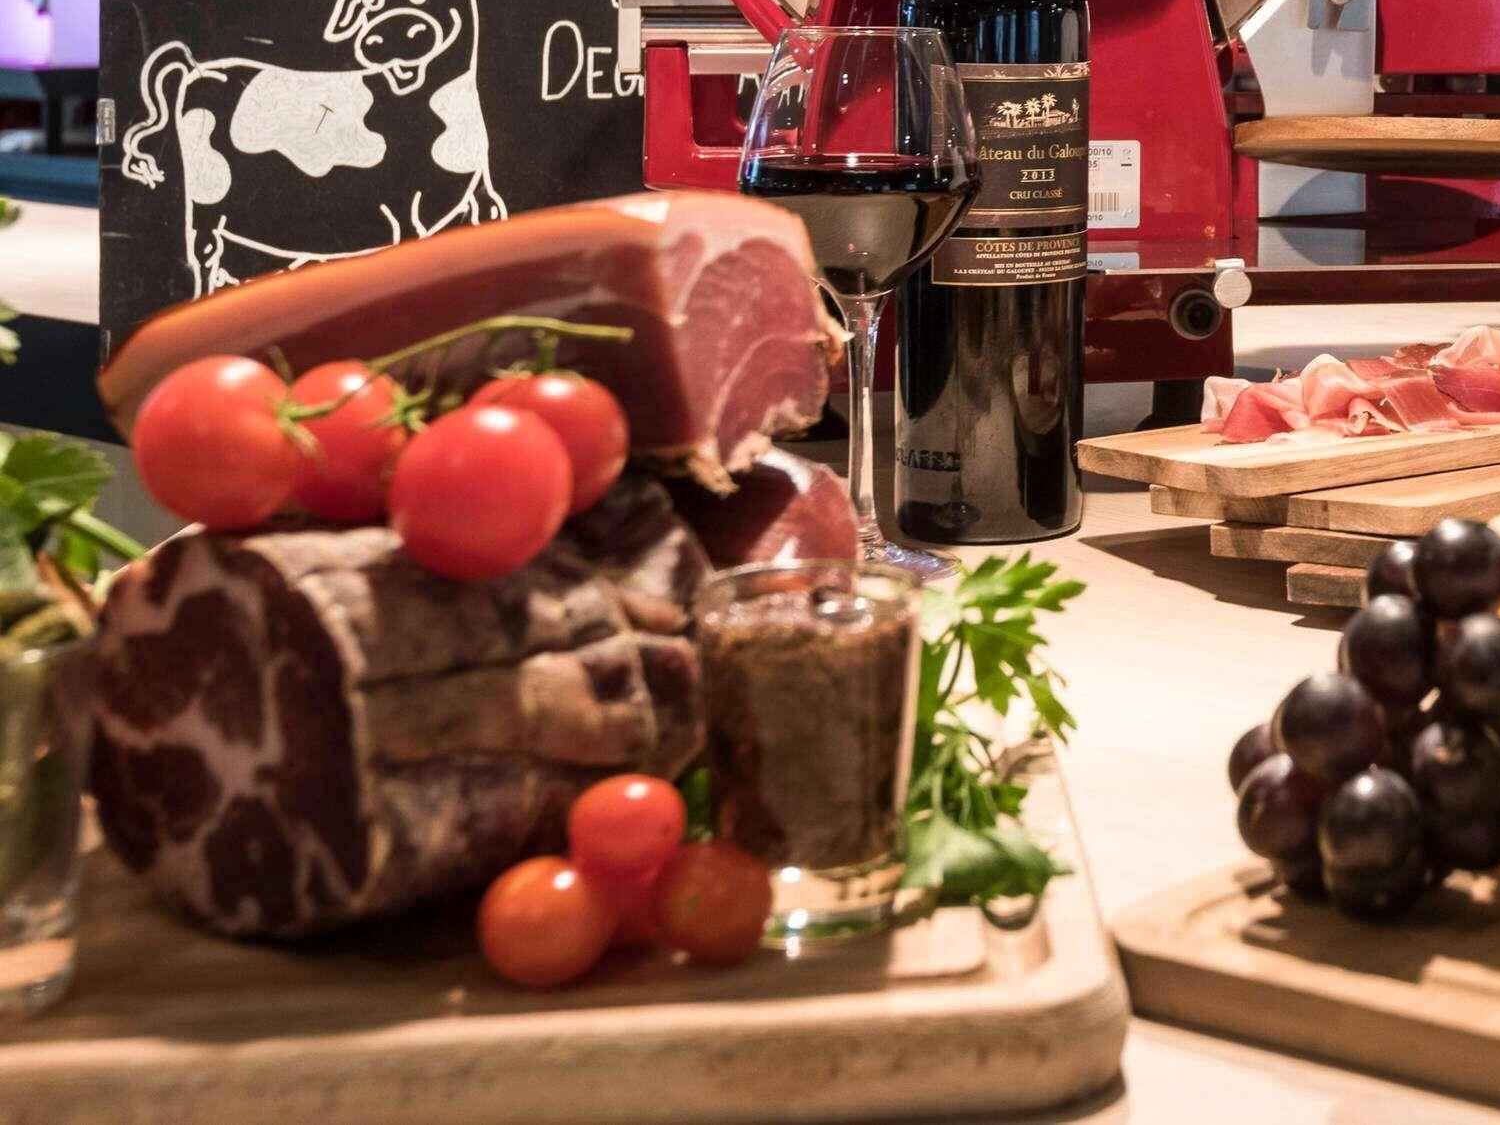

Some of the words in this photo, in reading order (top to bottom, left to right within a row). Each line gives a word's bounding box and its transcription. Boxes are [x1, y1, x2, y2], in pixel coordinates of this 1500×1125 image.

[1027, 145, 1046, 160] du
[1021, 169, 1056, 181] 2013
[1009, 190, 1031, 200] CRU
[975, 240, 1016, 253] CÔTES
[1018, 241, 1035, 252] DE
